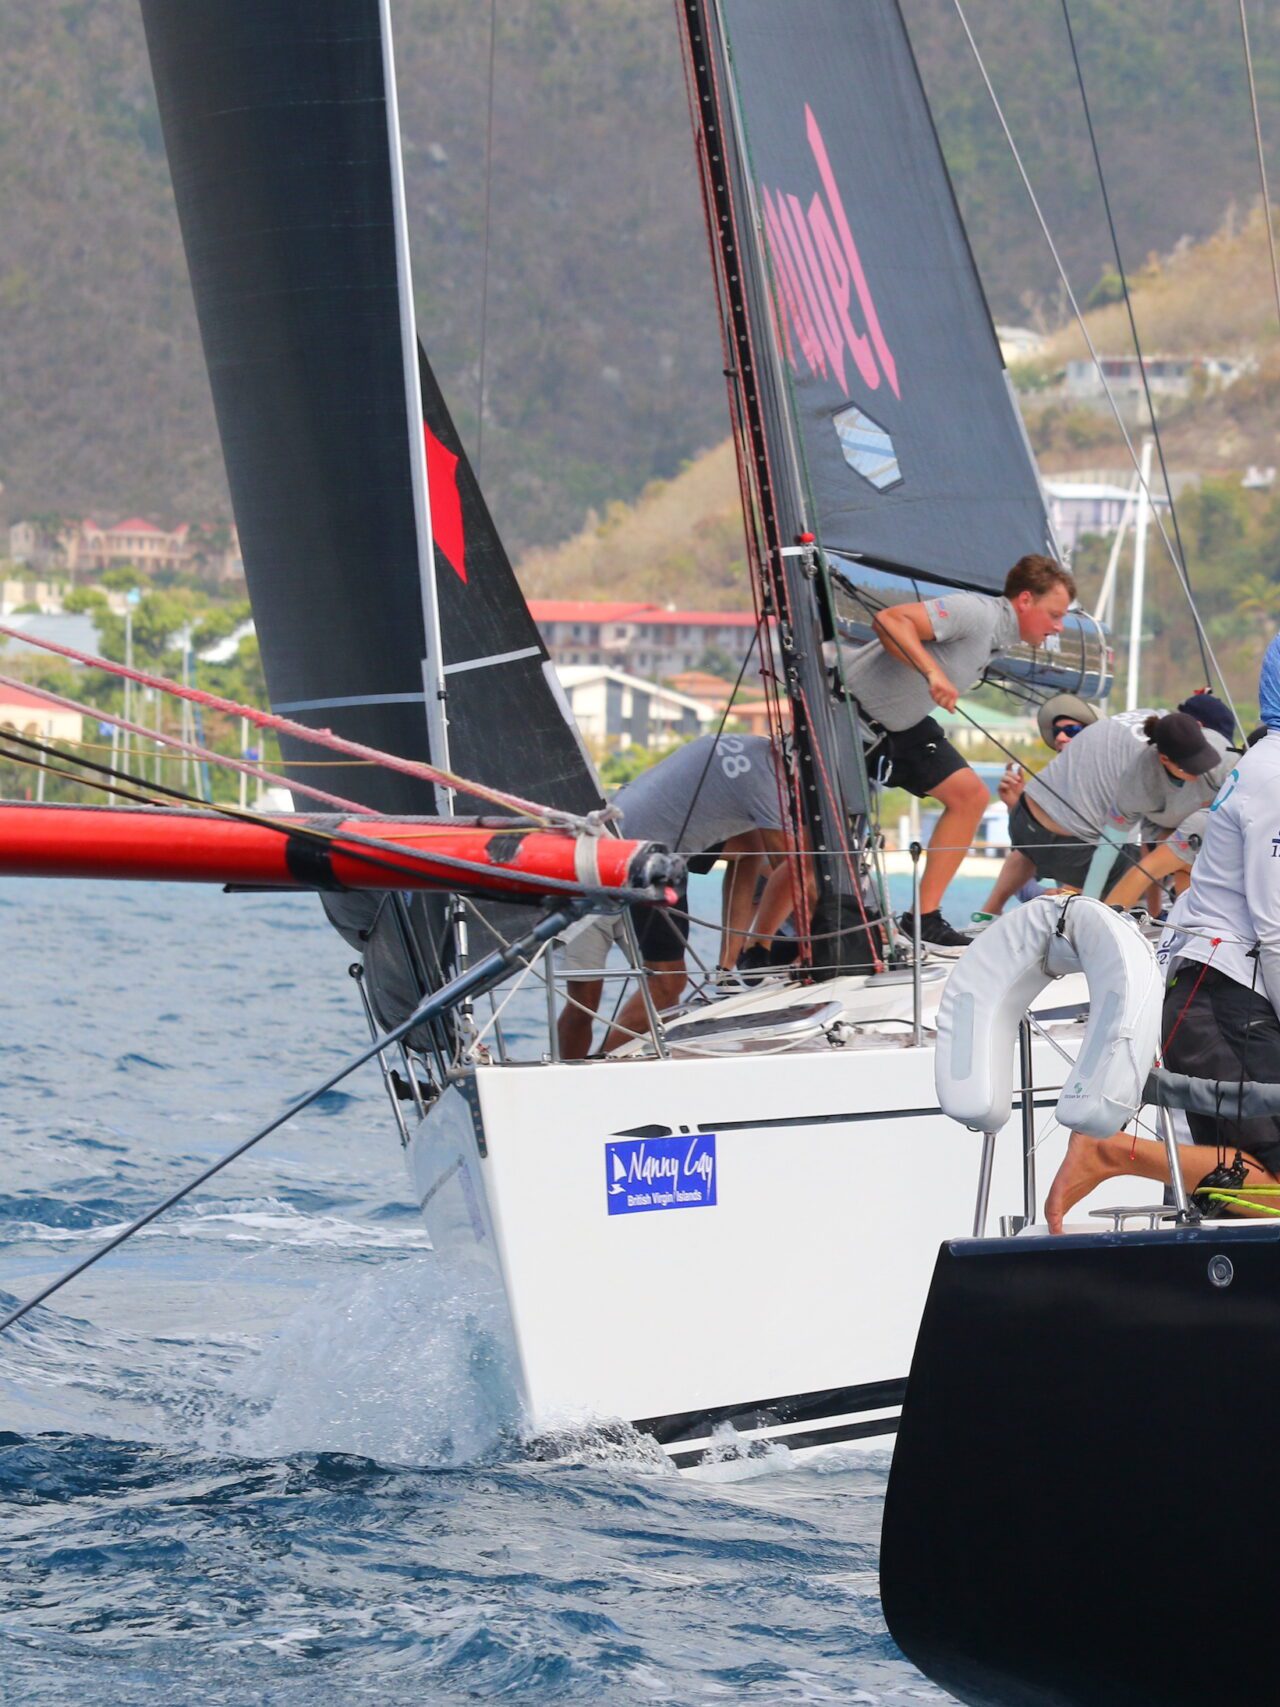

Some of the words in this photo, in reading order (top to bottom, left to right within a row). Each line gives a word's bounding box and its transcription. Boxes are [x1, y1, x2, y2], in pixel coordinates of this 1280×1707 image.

[627, 1142, 679, 1203] Nanny
[683, 1137, 713, 1201] Cay
[627, 1194, 652, 1207] British
[652, 1191, 674, 1206] Virgin
[676, 1189, 702, 1202] Islands
